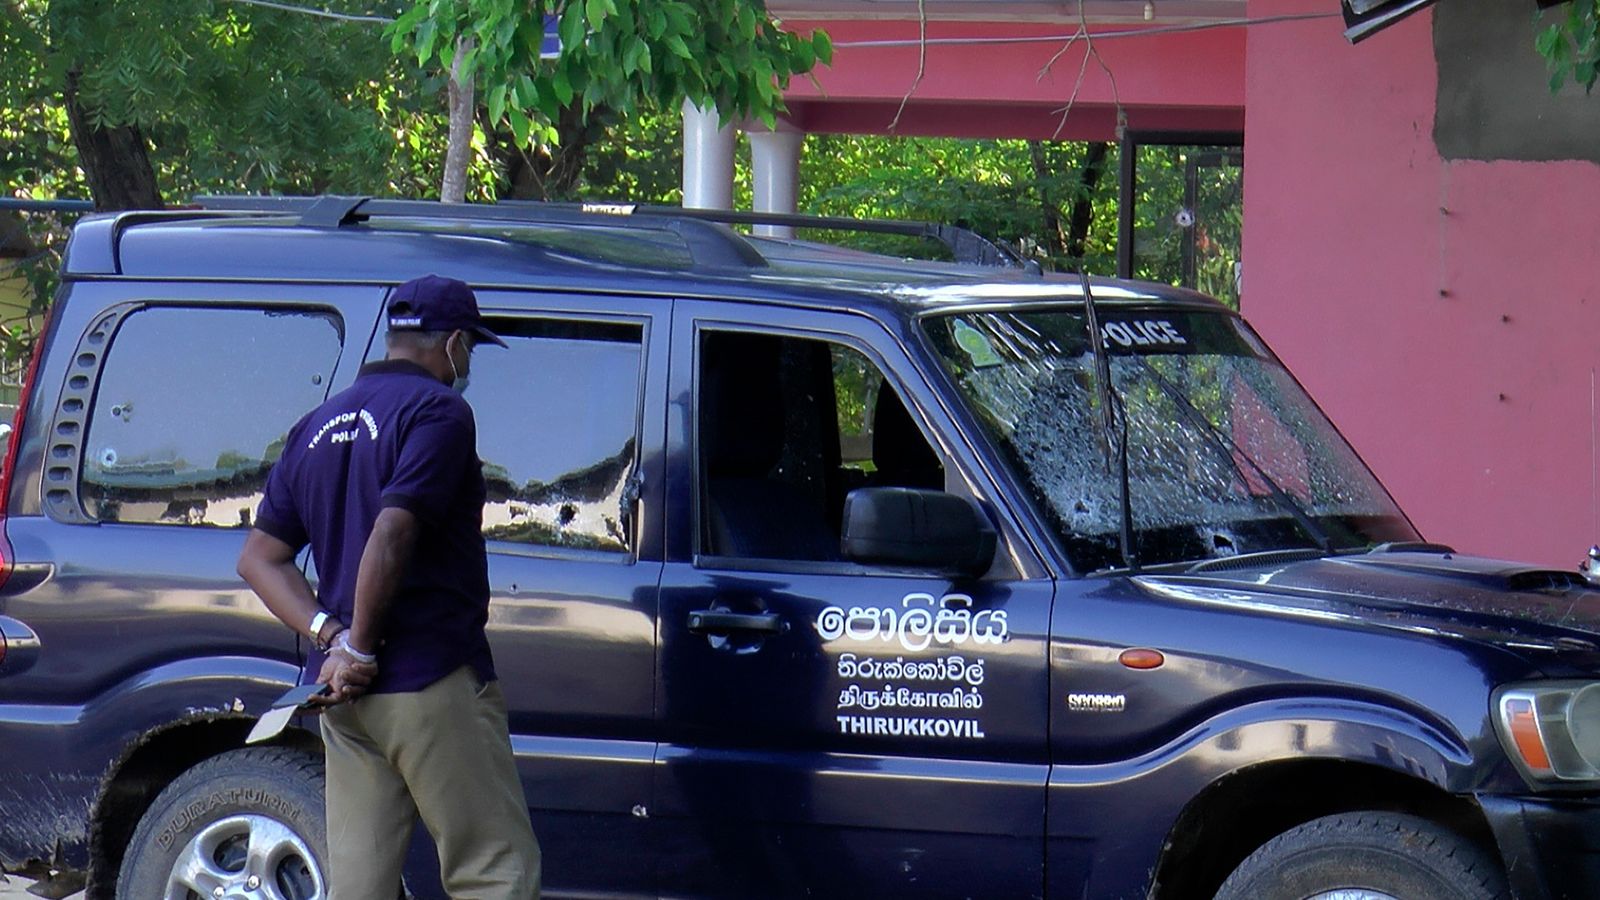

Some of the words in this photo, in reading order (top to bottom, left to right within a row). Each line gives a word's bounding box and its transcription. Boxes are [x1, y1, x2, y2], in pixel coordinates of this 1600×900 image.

[308, 412, 357, 448] TRANSPOR
[837, 685, 983, 709] திருக்கோவில்
[837, 715, 985, 738] THIRUKKOVIL
